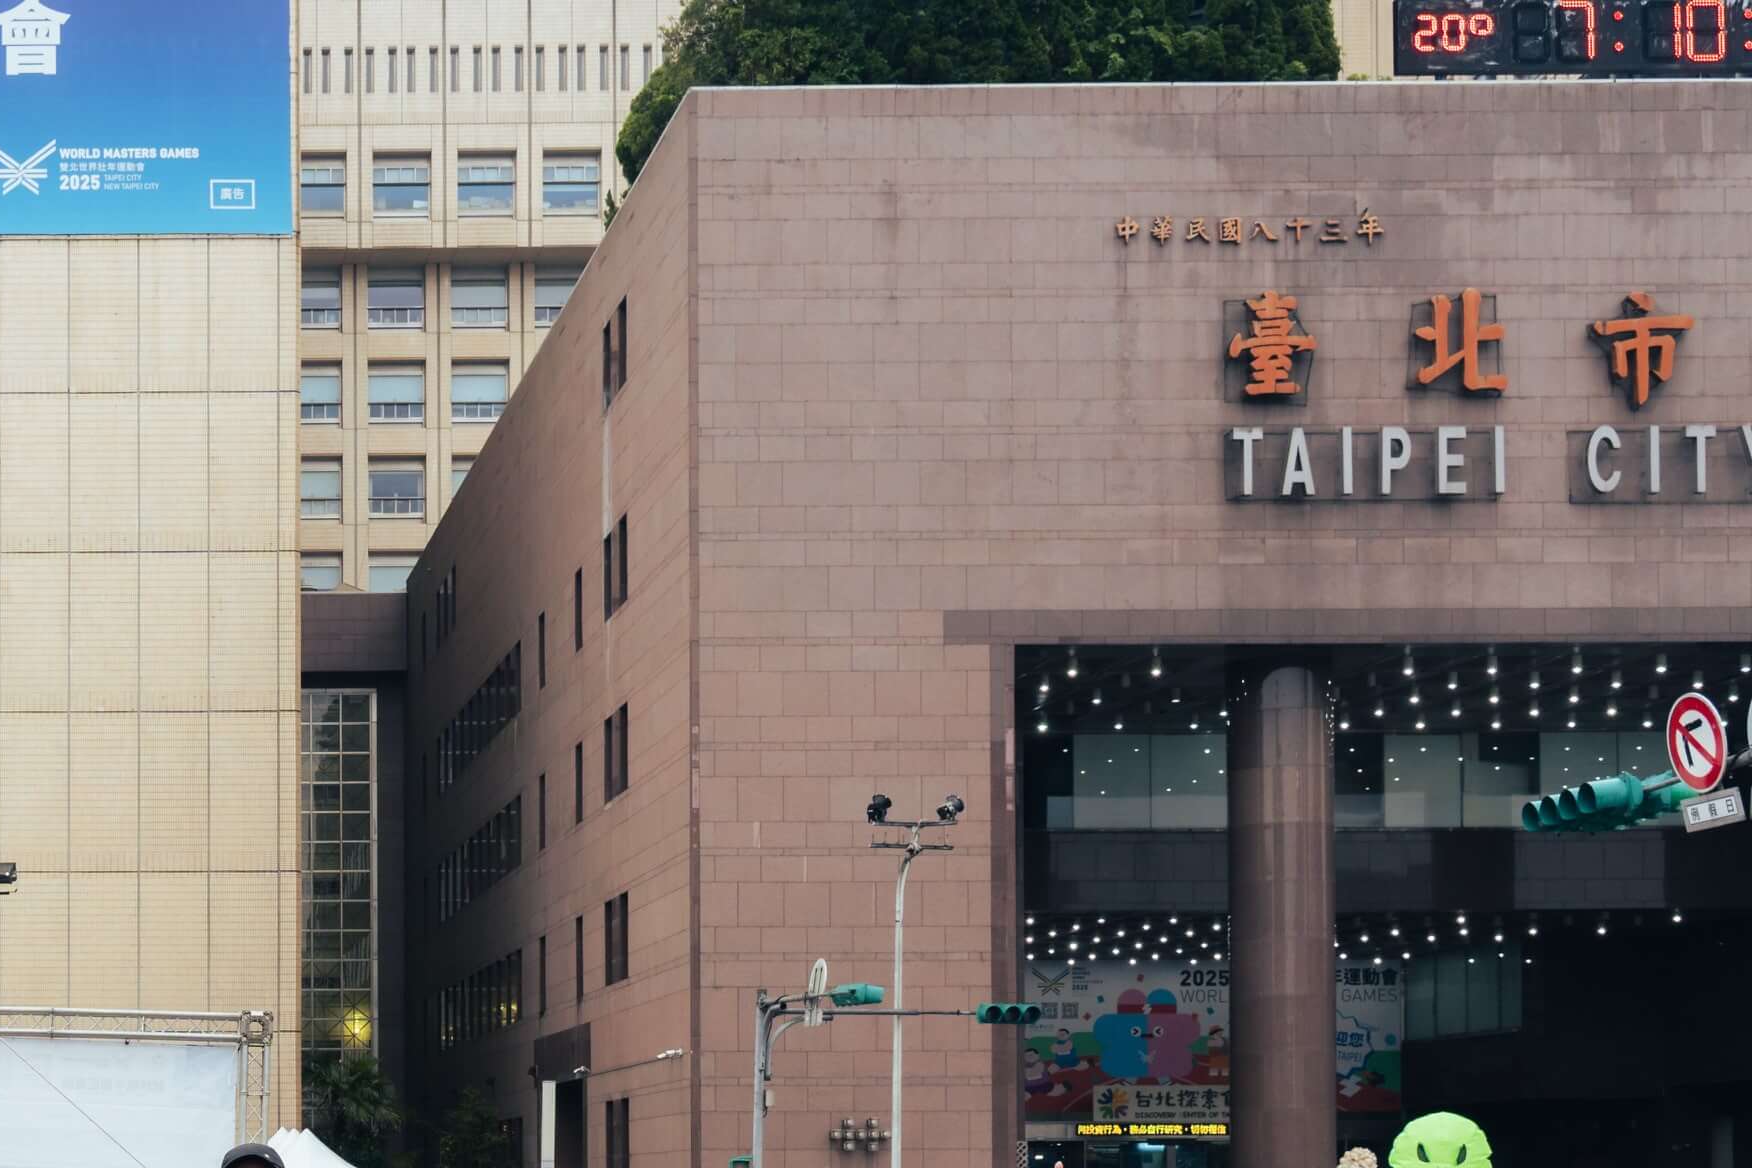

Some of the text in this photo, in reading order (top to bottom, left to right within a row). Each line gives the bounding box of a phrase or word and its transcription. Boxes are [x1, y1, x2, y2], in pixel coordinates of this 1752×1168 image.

[59, 147, 200, 159] WORLD MASTERS GAMES
[59, 174, 101, 191] 2025
[104, 174, 143, 182] TAIPEI CITY
[103, 183, 160, 191] NEW TAIPEI CITY
[220, 188, 245, 200] 廣告
[1114, 208, 1386, 245] 中華民國八十三年
[1227, 287, 1695, 407] 臺北市
[1231, 424, 1507, 497] TAIPEI
[1180, 969, 1230, 987] 2025
[1179, 989, 1228, 1003] WORL
[1340, 988, 1398, 1002] GAMES
[1179, 1111, 1207, 1119] ENTER
